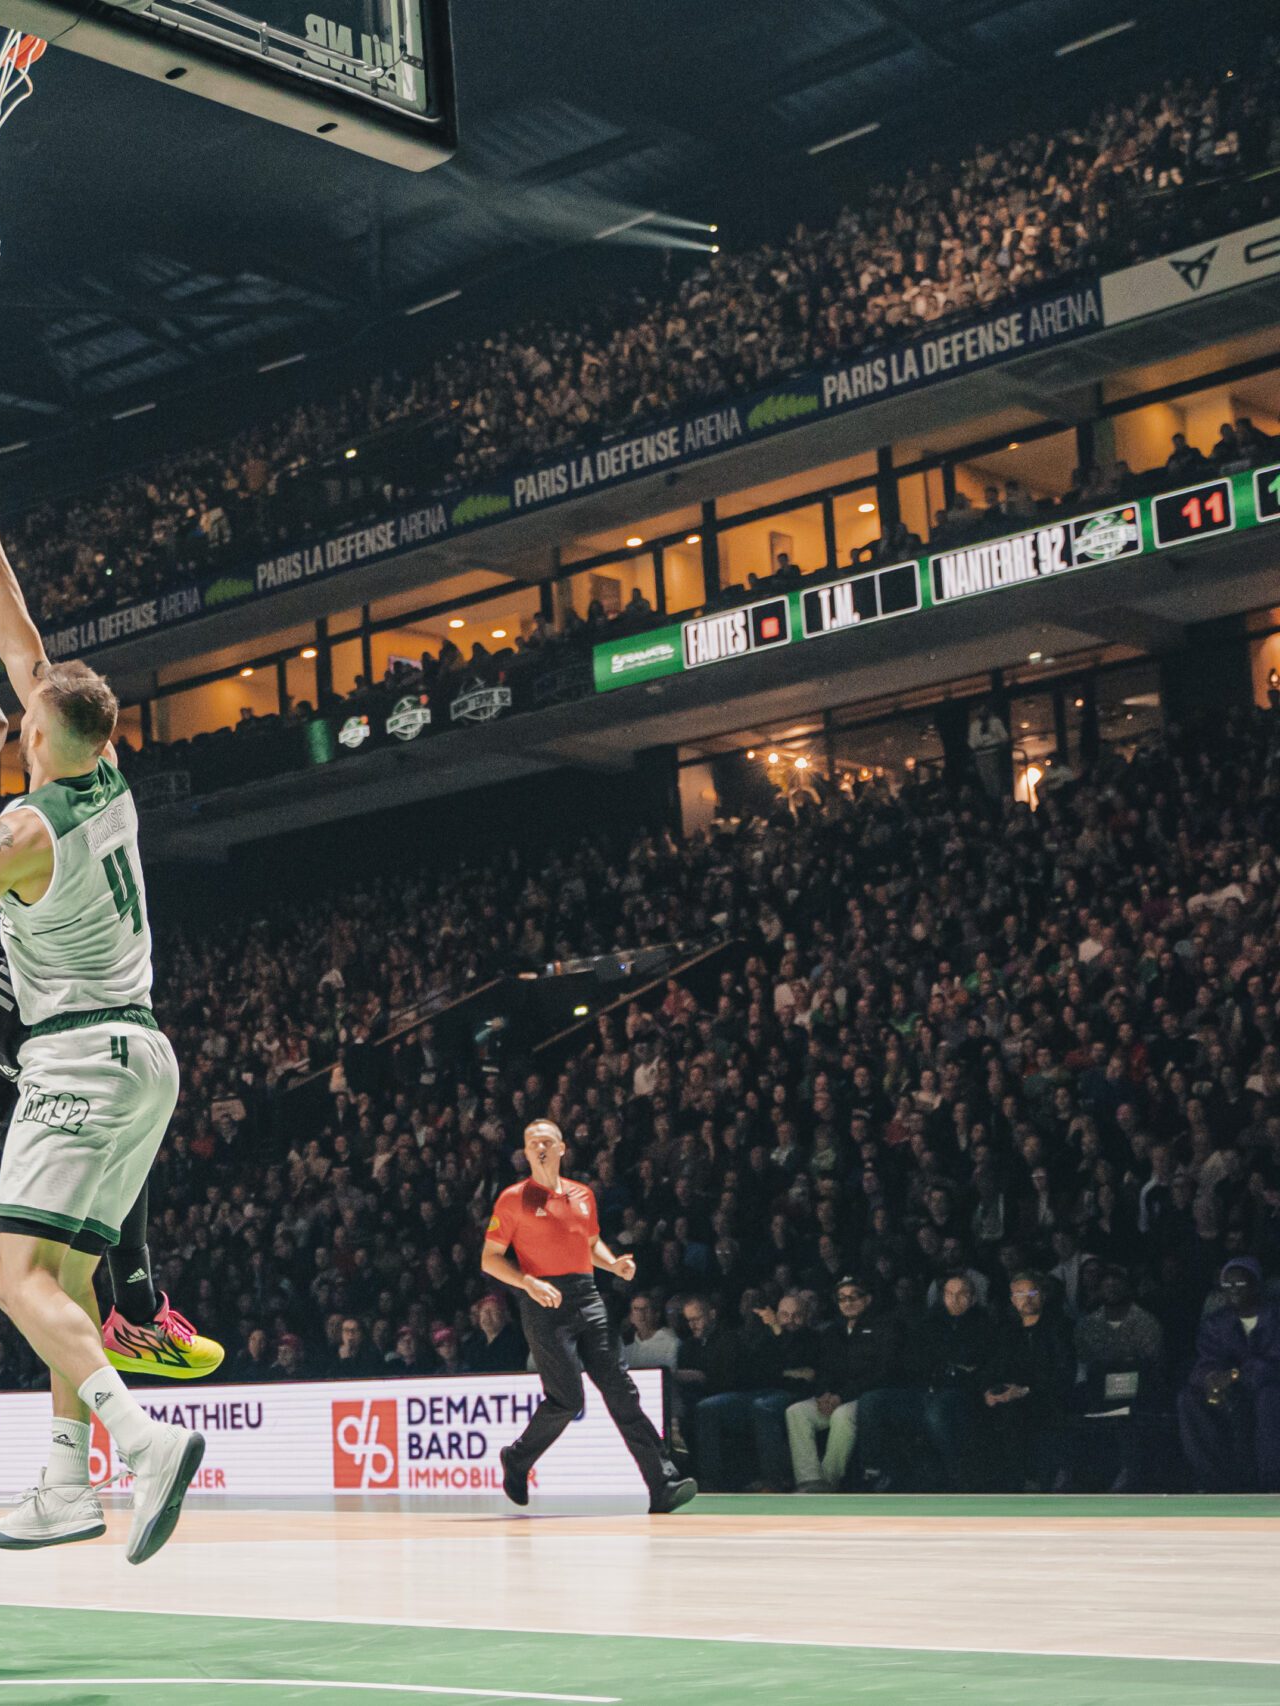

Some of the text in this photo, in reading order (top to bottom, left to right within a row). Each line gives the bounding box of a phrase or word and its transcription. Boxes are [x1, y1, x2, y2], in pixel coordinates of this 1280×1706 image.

[823, 289, 1100, 408] PARIS LA DEFENSE ARENA
[514, 407, 742, 508] PARIS LA DEFENSE ARENA
[1181, 492, 1225, 529] 11
[257, 503, 448, 590] PARIS LA DEFENSE ARENA
[940, 534, 1039, 600] NANTERRE
[1036, 525, 1068, 575] 92
[81, 621, 98, 648] LA
[99, 600, 158, 642] DEFENSE
[160, 587, 201, 623] ARENA
[686, 611, 748, 665] FAUTES
[101, 845, 144, 937] 4
[110, 1036, 129, 1068] 4
[144, 1402, 262, 1430] MATHIEU
[407, 1394, 584, 1425] DEMATH
[407, 1431, 487, 1460] BARD
[408, 1466, 538, 1488] IMMOBILR
